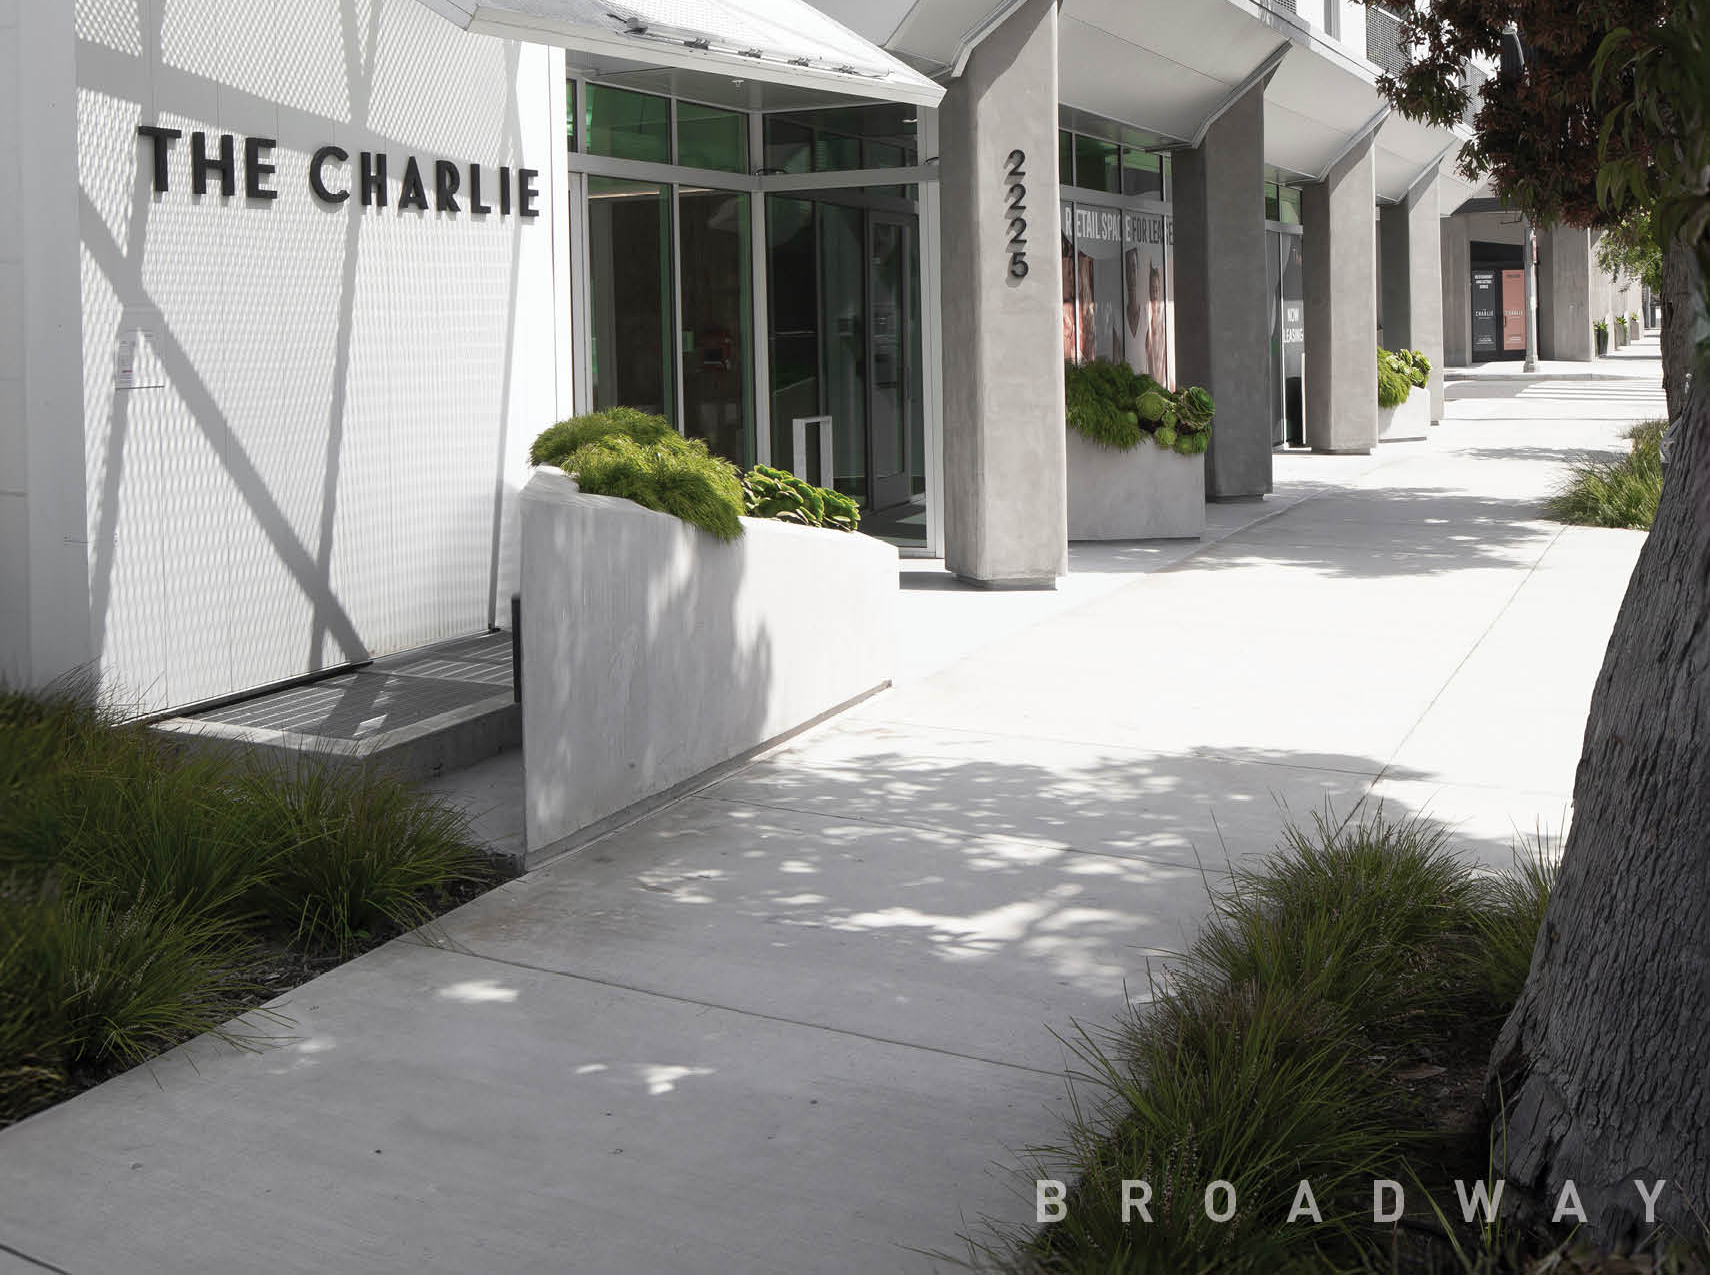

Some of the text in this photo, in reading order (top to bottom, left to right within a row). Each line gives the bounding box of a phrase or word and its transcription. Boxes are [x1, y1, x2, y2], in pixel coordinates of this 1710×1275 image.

[137, 125, 540, 217] THE CHARLIE
[1006, 148, 1029, 278] 2225
[1064, 206, 1100, 239] RETAIL
[1132, 216, 1147, 244] FOR
[1286, 308, 1300, 322] NOW
[1283, 328, 1304, 343] LEASING
